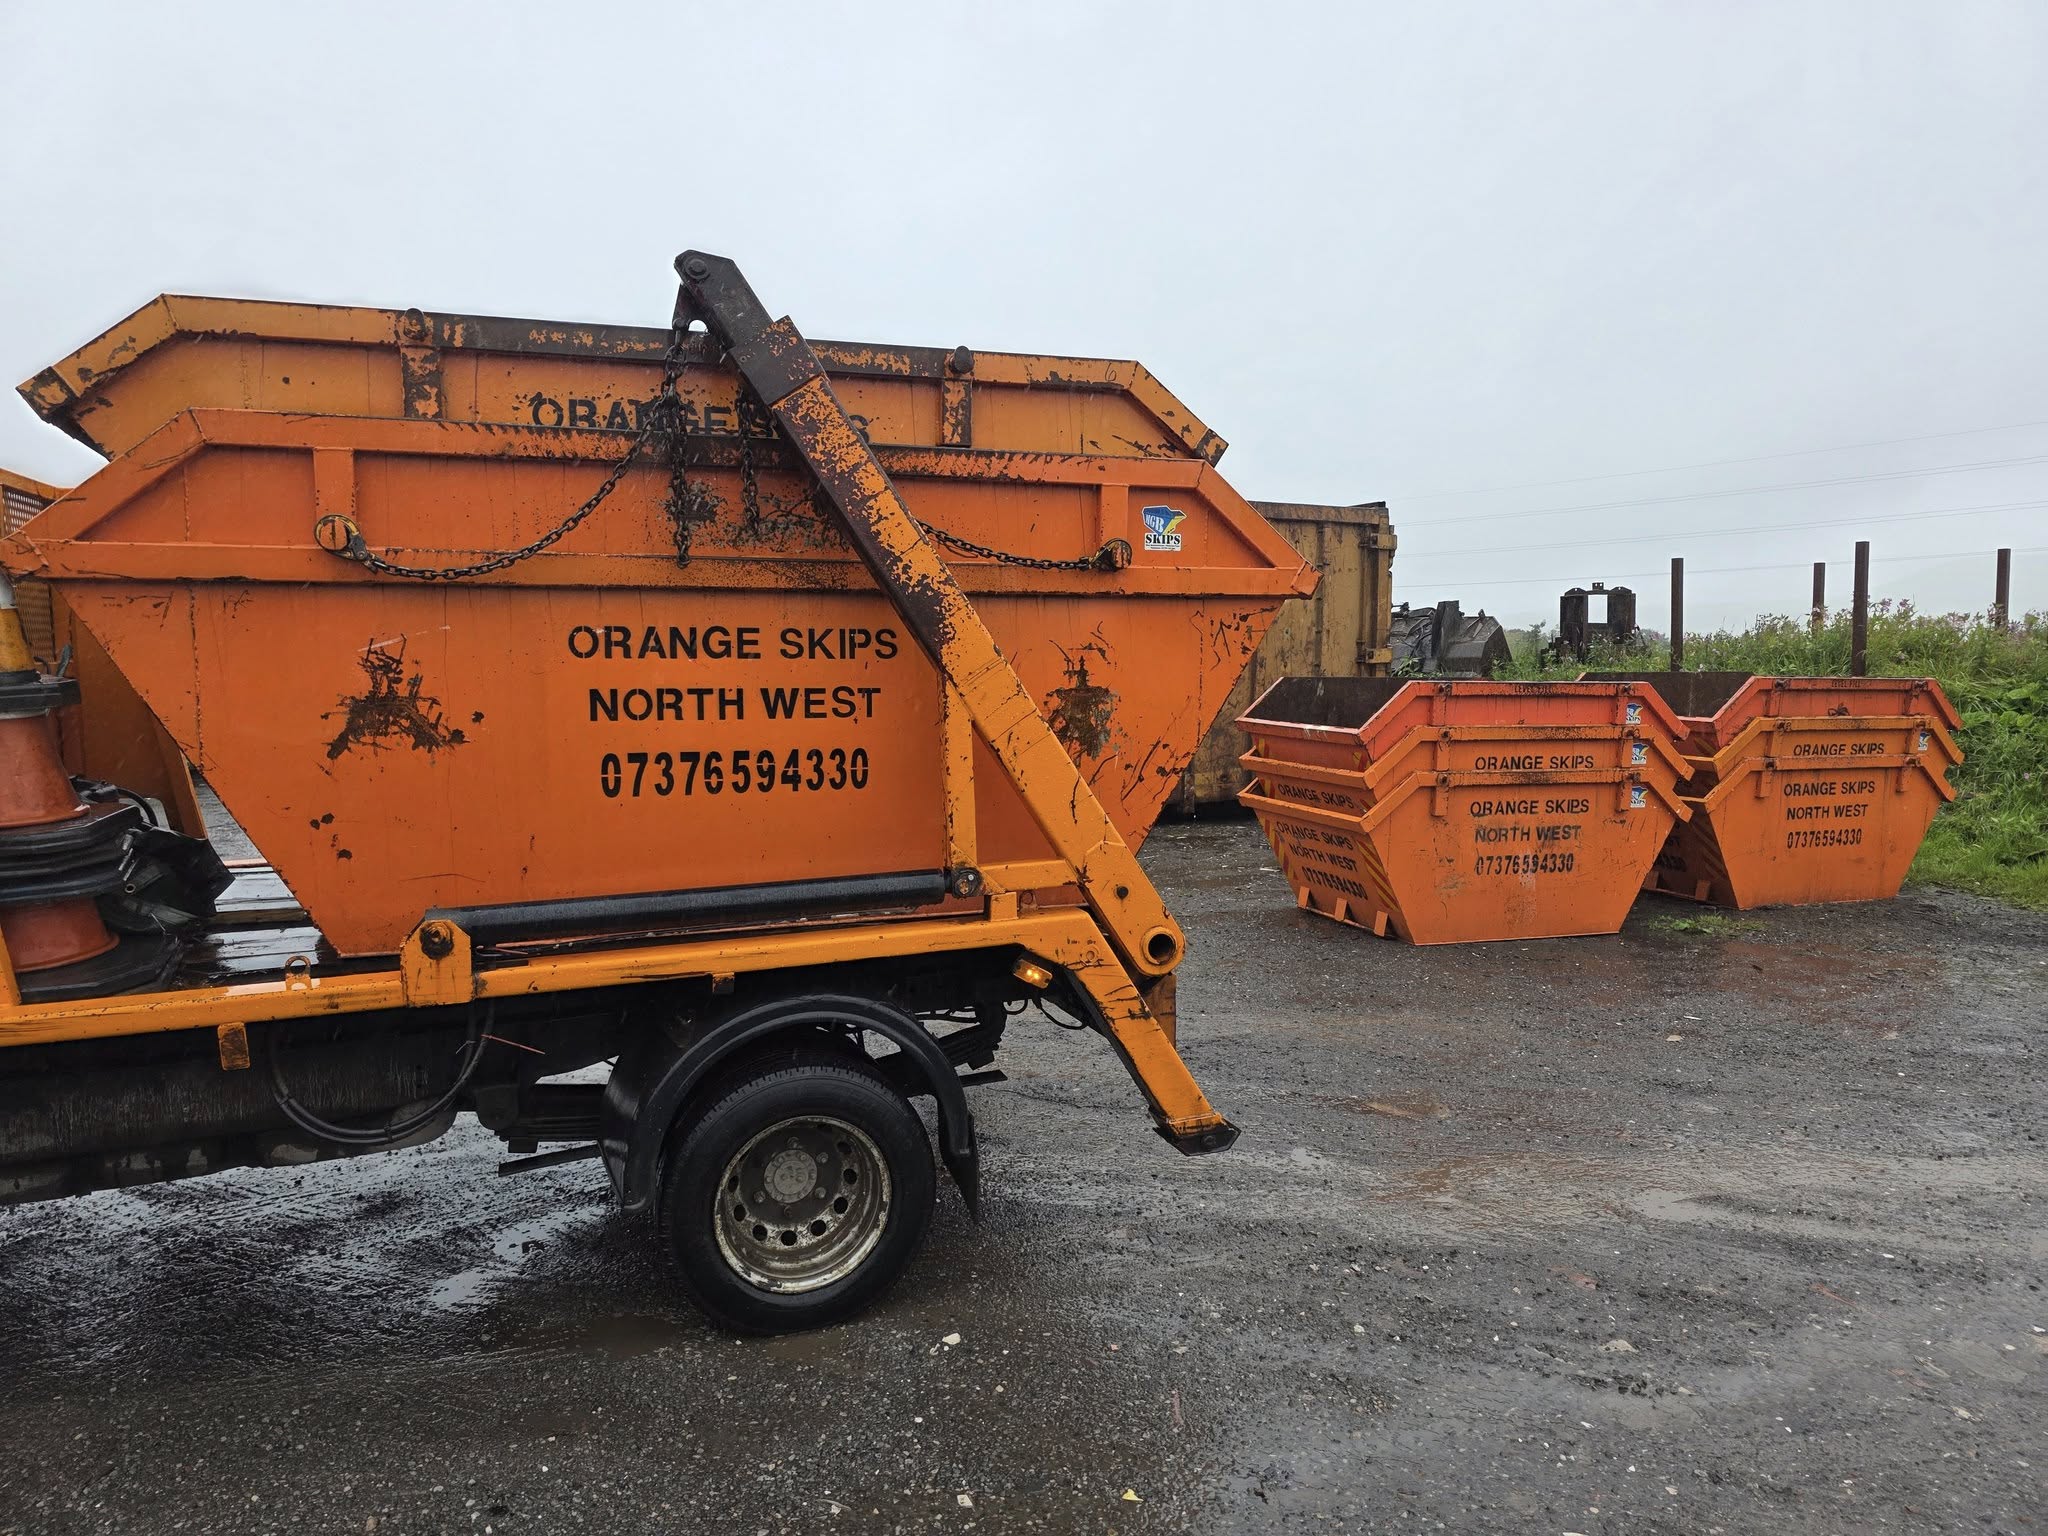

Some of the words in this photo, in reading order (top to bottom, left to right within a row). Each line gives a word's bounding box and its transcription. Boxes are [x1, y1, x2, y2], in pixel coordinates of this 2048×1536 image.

[1146, 534, 1180, 544] SKIPS
[568, 625, 761, 659] ORANGE
[780, 628, 898, 660] SKIPS
[589, 688, 744, 721] NORTH
[760, 686, 881, 719] WEST
[1793, 743, 1845, 756] ORANGE
[1850, 743, 1885, 755] SKIPS
[601, 747, 869, 798] 07376594330
[1474, 756, 1544, 771] ORANGE
[1549, 755, 1594, 769] SKIPS
[1278, 784, 1320, 801] ORANGE
[1322, 792, 1354, 808] SKIPS
[1784, 782, 1836, 796] ORANGE
[1841, 781, 1875, 794] SKIPS
[1470, 800, 1539, 816] ORANGE
[1544, 799, 1590, 814] SKIPS
[1787, 806, 1829, 820] NORTH
[1834, 804, 1868, 817] WEST
[1277, 822, 1320, 841] ORANGE
[1322, 832, 1354, 850] SKIPS
[1476, 827, 1530, 843] NORTH
[1536, 825, 1582, 840] WEST
[1787, 829, 1862, 849] 07376594330
[1290, 844, 1325, 863] NORTH
[1326, 853, 1358, 872] WEST
[1476, 854, 1574, 875] 07376594330
